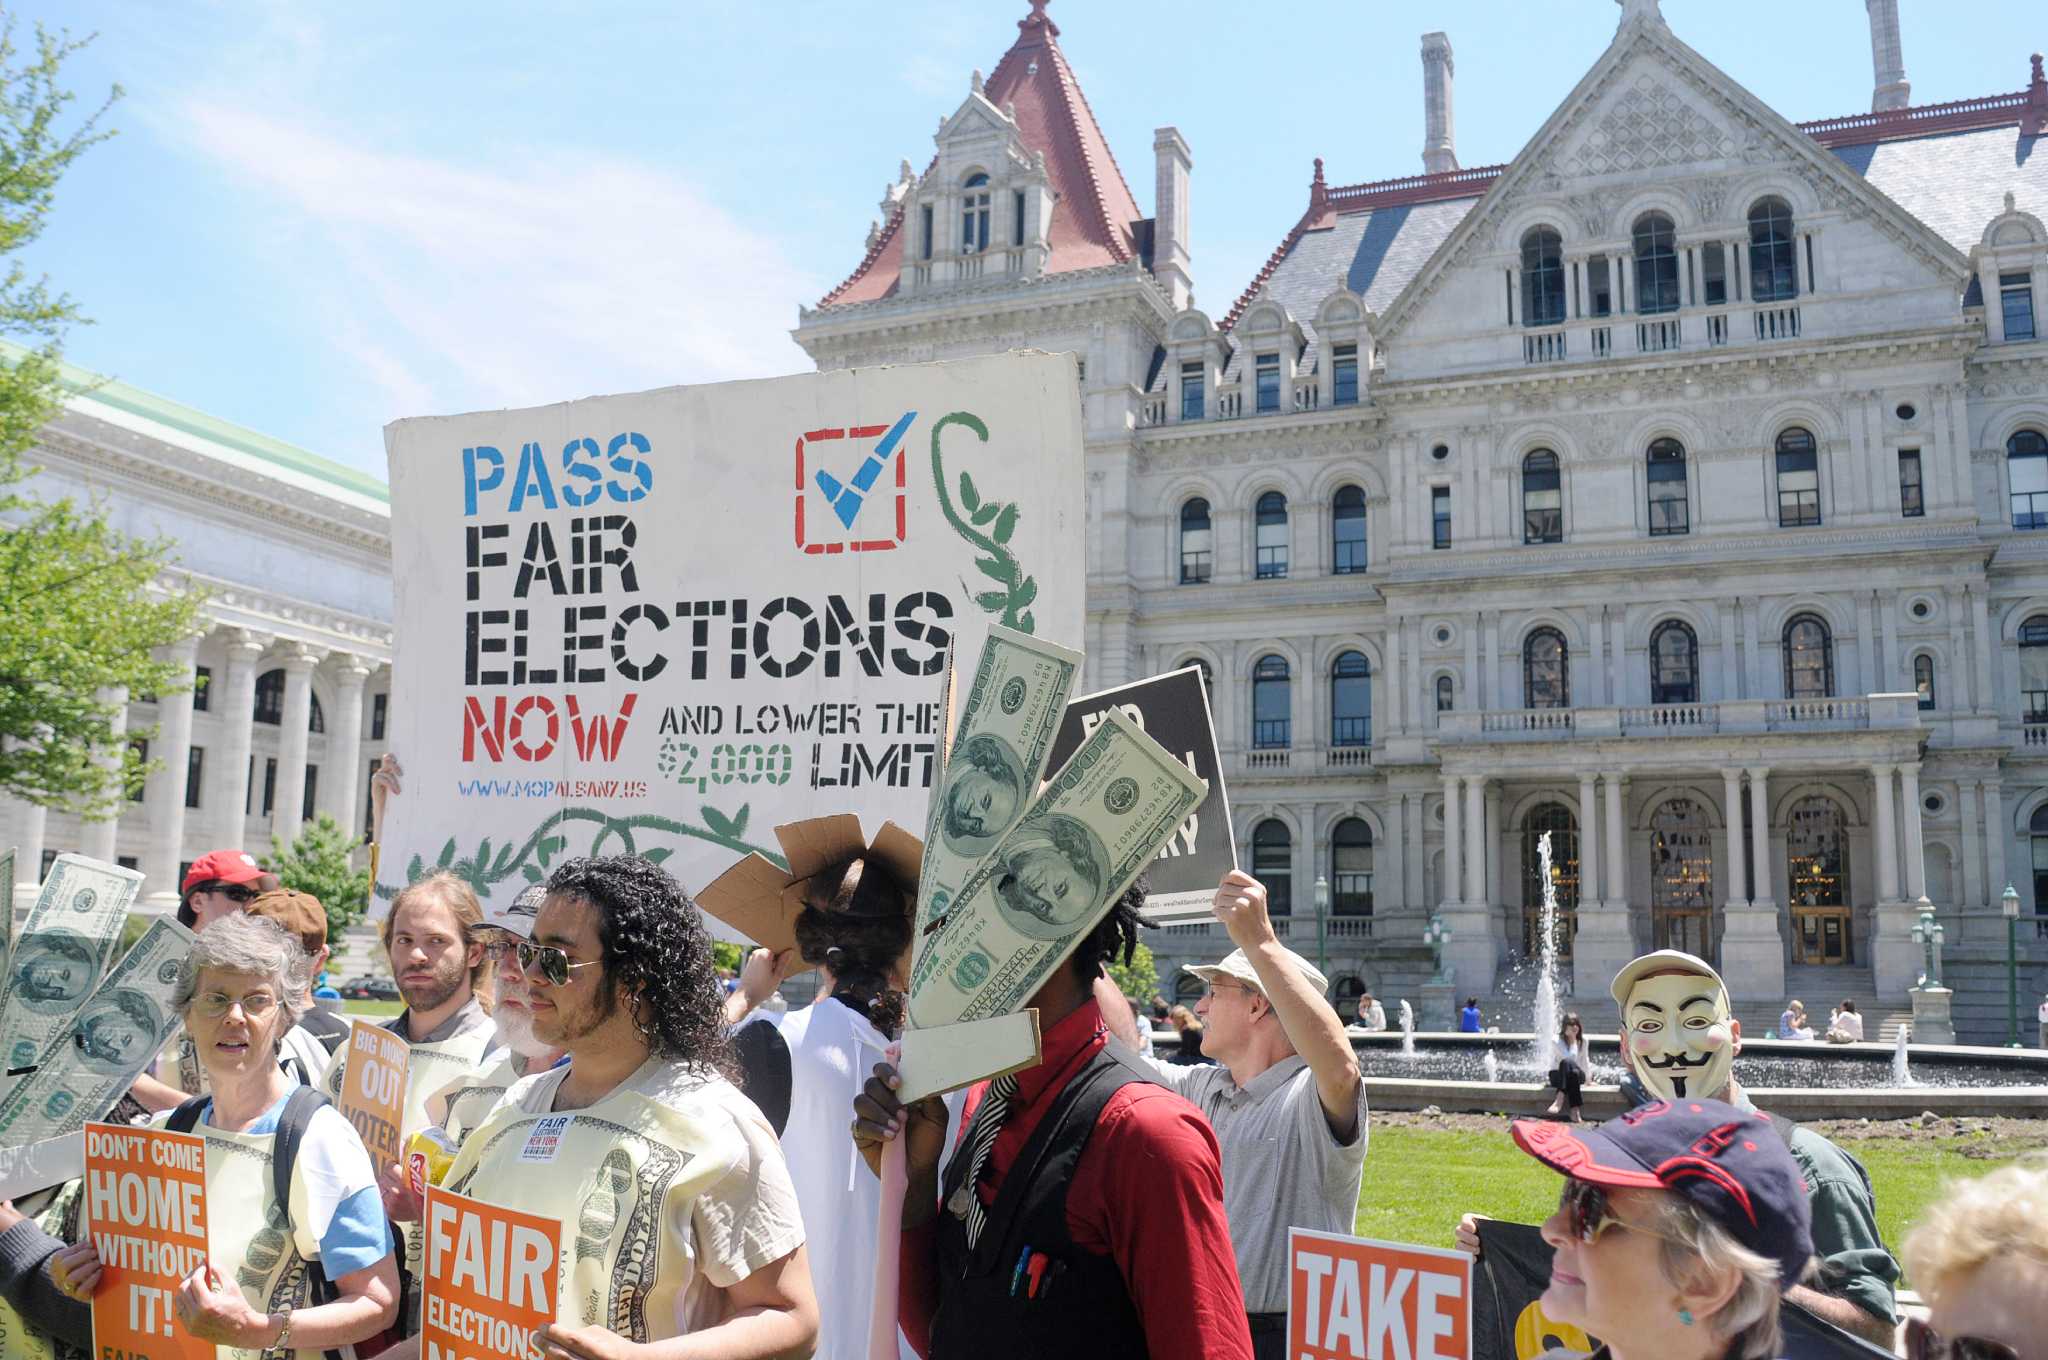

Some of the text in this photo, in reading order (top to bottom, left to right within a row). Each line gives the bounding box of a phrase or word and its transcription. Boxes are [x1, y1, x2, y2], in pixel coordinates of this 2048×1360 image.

[462, 432, 653, 516] PASS
[466, 515, 640, 600] FAIR
[465, 591, 954, 686] ELECTIONS
[462, 693, 638, 762] NOW
[659, 704, 723, 735] AND
[735, 702, 861, 736] LOWER
[657, 738, 935, 794] $2,000 LIMIT
[355, 1029, 378, 1056] BIG
[361, 1060, 401, 1111] OUT
[88, 1131, 203, 1174] DON'T COME
[537, 1117, 568, 1129] FAIR
[90, 1169, 205, 1239] HOME
[430, 1201, 554, 1313] FAIR
[129, 1283, 173, 1337] IT!
[428, 1293, 545, 1360] ELECTIONS
[1296, 1251, 1462, 1360] TAKE
